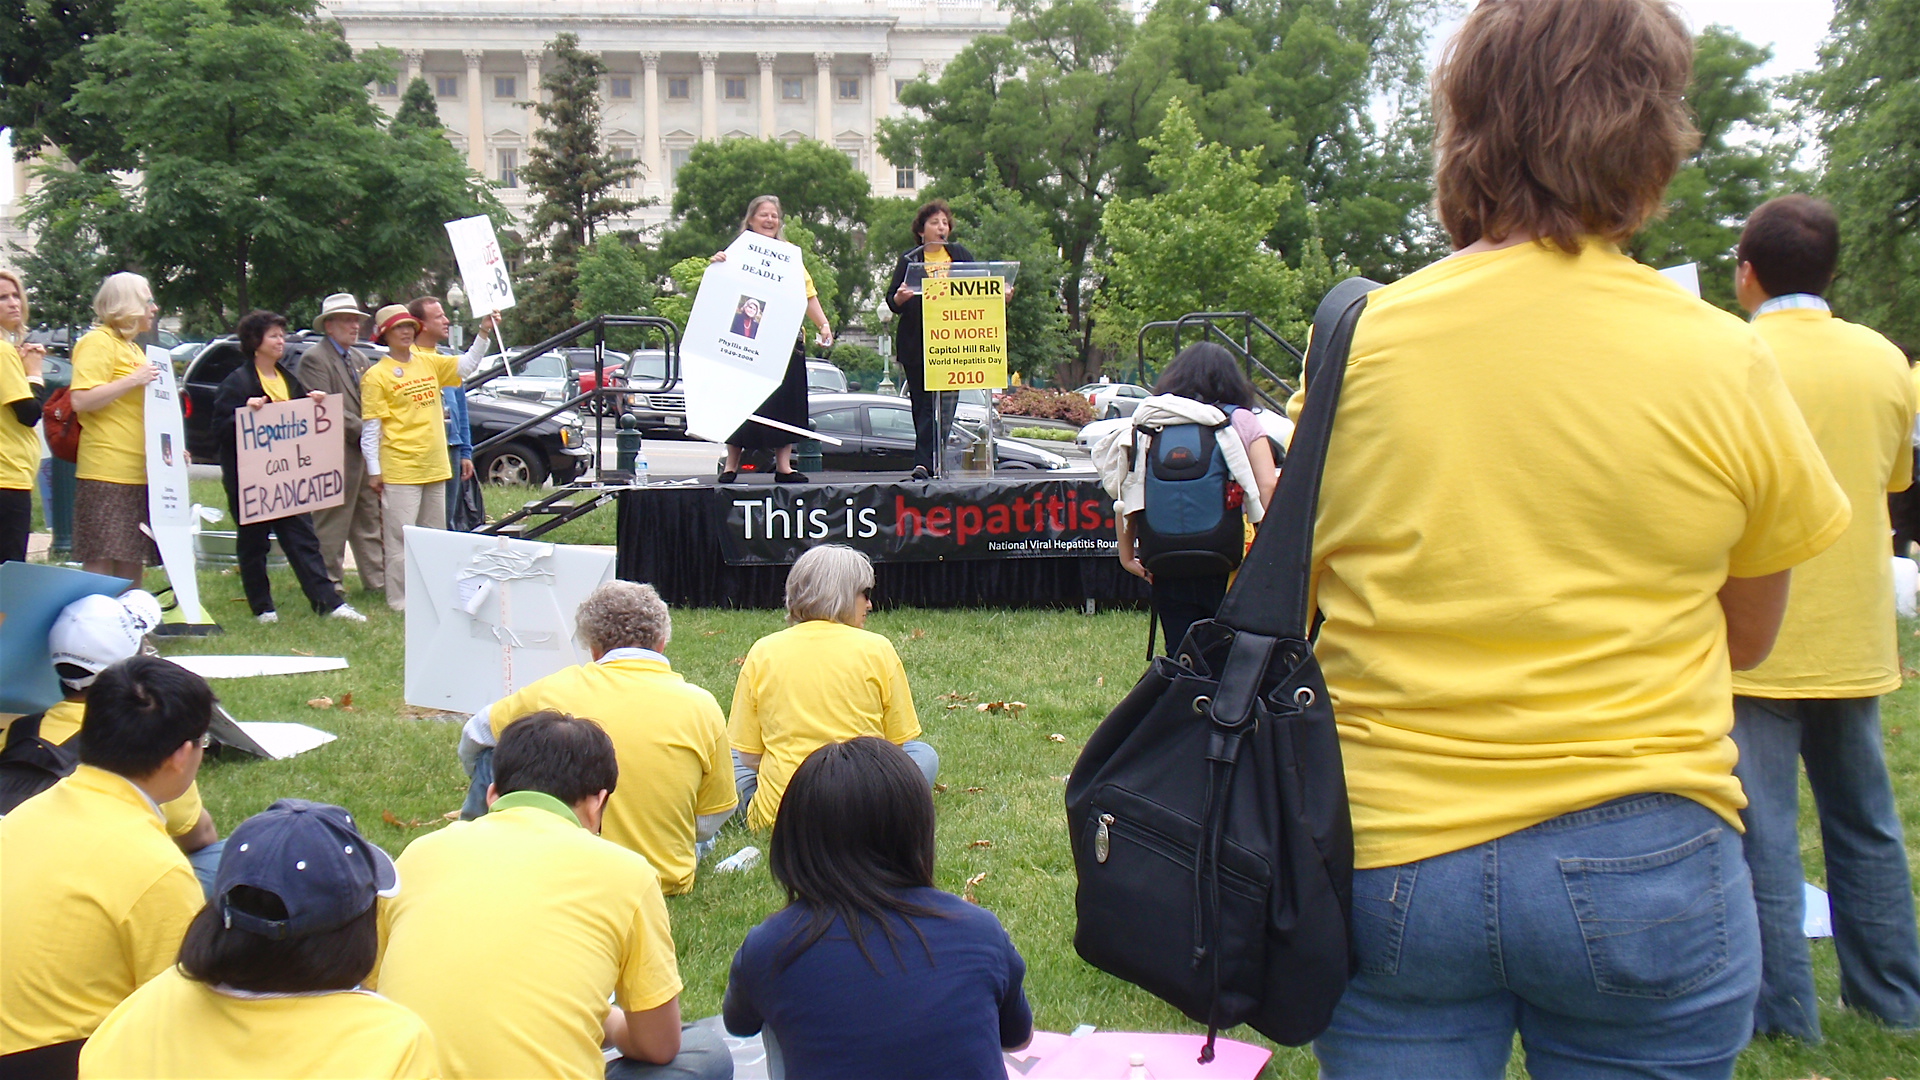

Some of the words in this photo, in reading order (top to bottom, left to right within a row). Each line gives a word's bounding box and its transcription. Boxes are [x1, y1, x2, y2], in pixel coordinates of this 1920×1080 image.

[747, 243, 791, 263] SILENCE
[761, 259, 771, 267] IS
[742, 264, 784, 282] DEADLY
[950, 280, 1001, 296] NVHR
[942, 309, 985, 321] SILENT
[930, 329, 950, 340] NO
[954, 327, 998, 339] MORE!
[718, 338, 742, 350] Phyllis
[743, 346, 759, 356] Beck
[929, 345, 960, 355] Capitol
[962, 345, 977, 353] Hill
[979, 344, 1001, 353] Rally
[953, 357, 986, 366] Hepatitis
[988, 356, 1002, 364] Day
[947, 370, 985, 384] 2010
[411, 390, 435, 402] 2010
[240, 411, 308, 452] Hepatitis
[314, 404, 332, 434] B
[266, 458, 289, 476] can
[296, 444, 312, 468] be
[243, 469, 343, 518] ERADICATED
[733, 497, 829, 539] This
[846, 498, 878, 538] is
[895, 490, 1114, 545] hepatitis.
[988, 540, 1028, 550] National
[1029, 539, 1051, 549] Viral
[1053, 539, 1095, 551] Hepatitis
